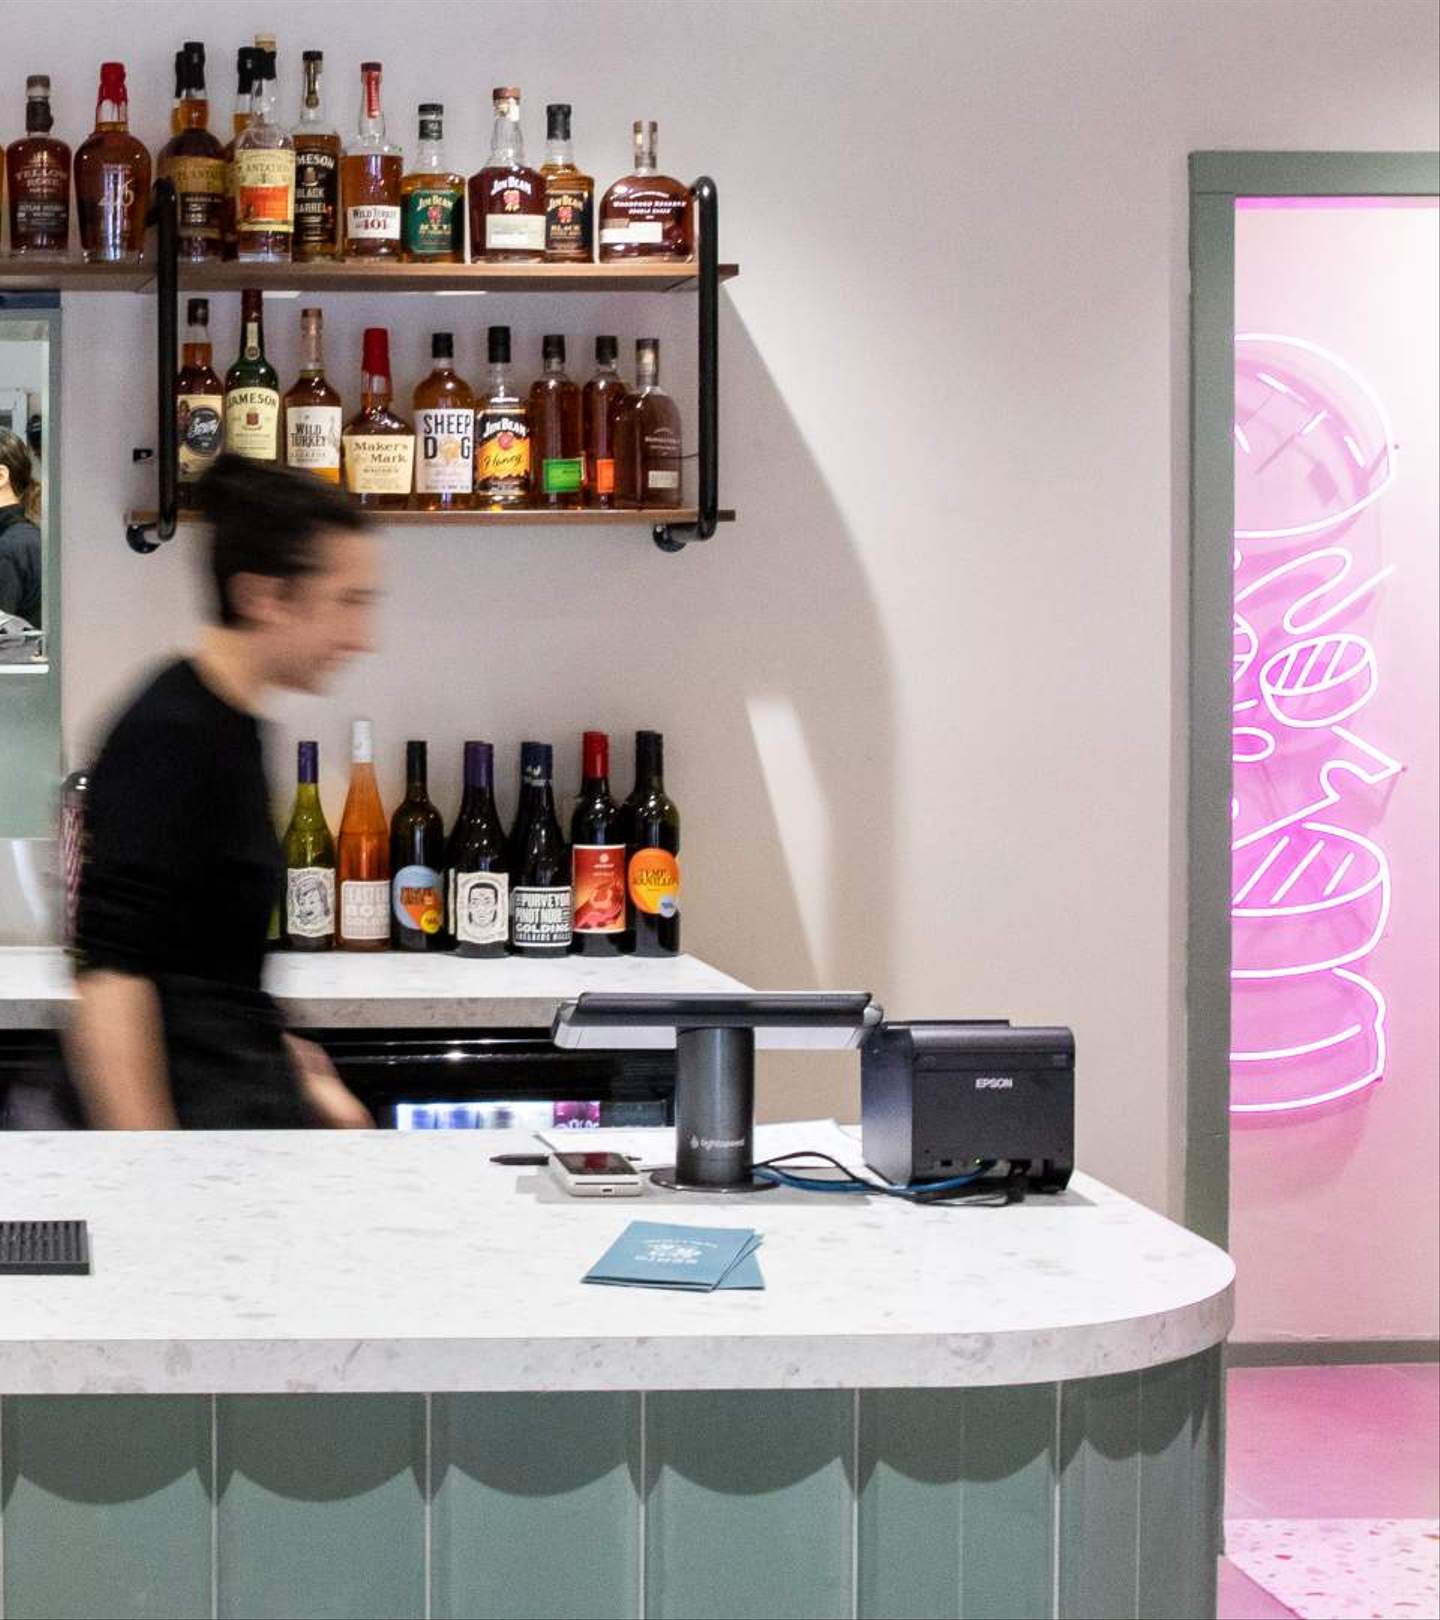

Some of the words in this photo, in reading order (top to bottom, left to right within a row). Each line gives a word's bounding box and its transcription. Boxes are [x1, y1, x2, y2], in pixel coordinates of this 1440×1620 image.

[297, 153, 334, 169] MESON
[16, 169, 68, 181] YELLOW
[508, 176, 532, 195] BEAM
[364, 219, 388, 231] 101
[227, 393, 276, 409] JAMESON
[296, 423, 322, 434] WILD
[423, 413, 472, 435] SHEEP
[482, 420, 501, 437] JIM
[502, 417, 528, 437] BEAM
[291, 432, 326, 447] TURKEY
[353, 441, 408, 452] Maker's
[371, 453, 408, 463] Mark
[516, 923, 570, 933] GOLDING
[975, 1078, 1013, 1089] EPSON
[700, 1135, 745, 1150] lightspeed
